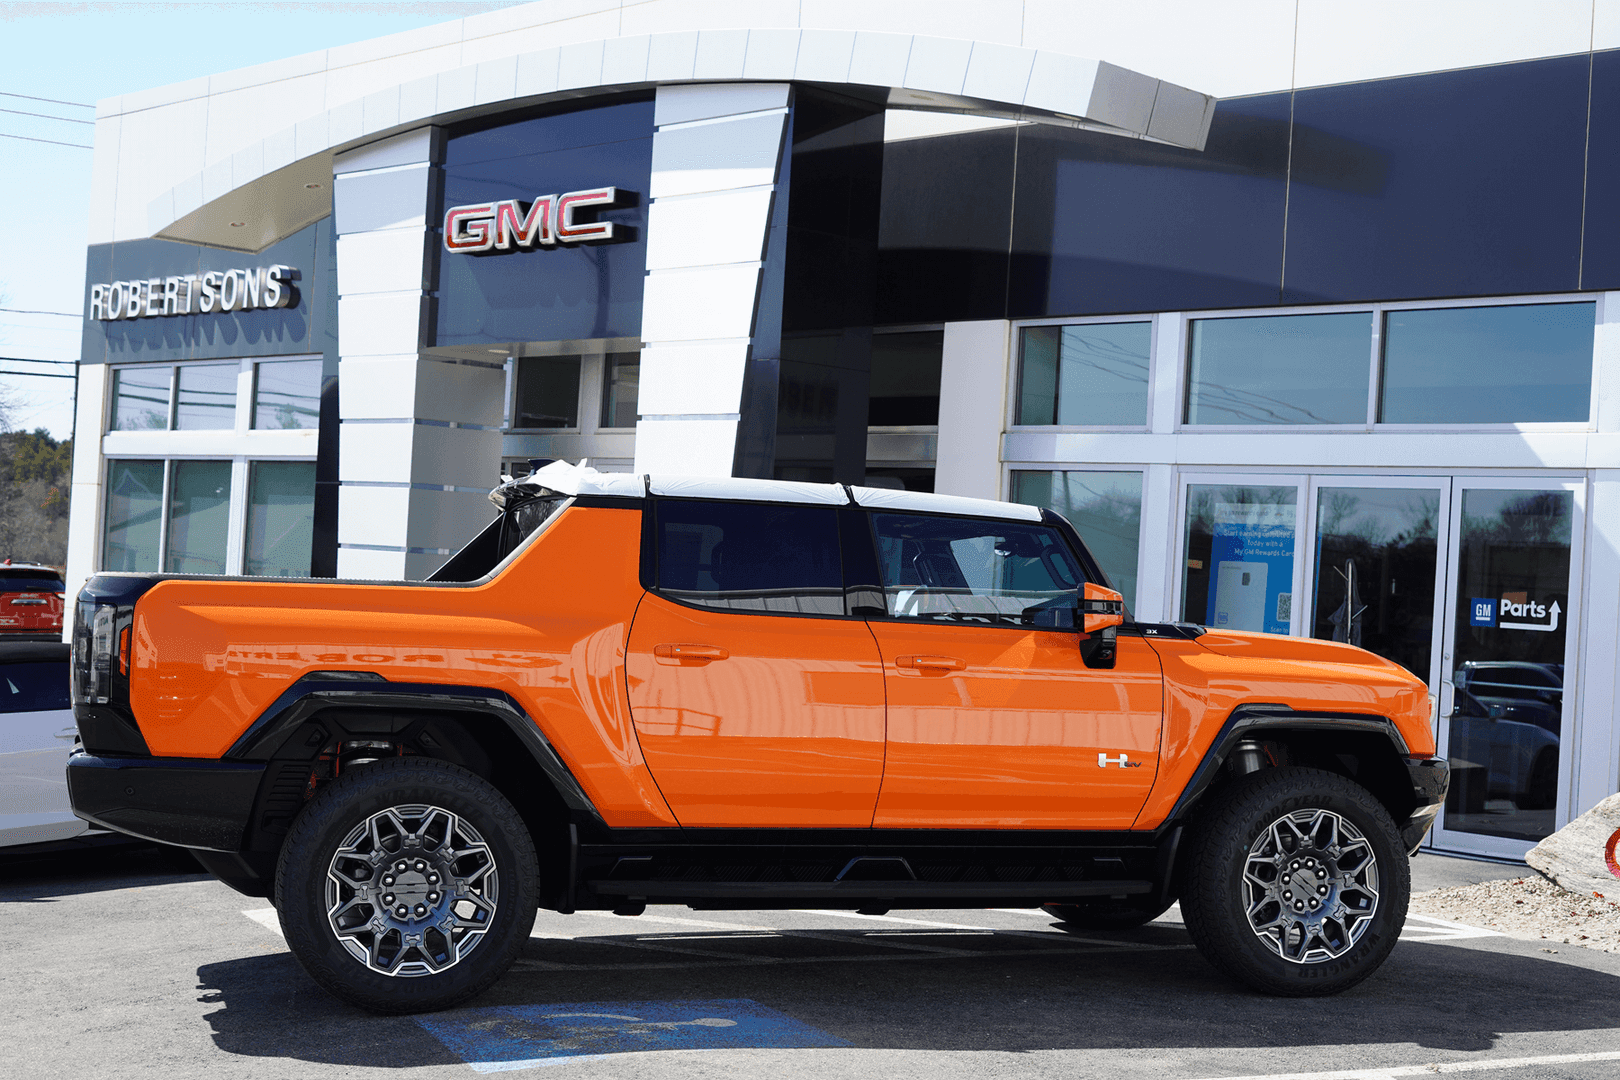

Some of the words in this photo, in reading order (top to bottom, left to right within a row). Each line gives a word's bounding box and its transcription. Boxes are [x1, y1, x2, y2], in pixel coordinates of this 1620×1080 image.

[443, 186, 616, 253] GMC
[90, 264, 284, 320] ROBERTSONS
[1234, 548, 1243, 556] My
[1255, 549, 1280, 557] Rewards
[1476, 604, 1491, 617] GM
[1500, 599, 1546, 618] Parts
[374, 788, 484, 820] WRANGLER
[1298, 933, 1380, 979] WRANGLER
